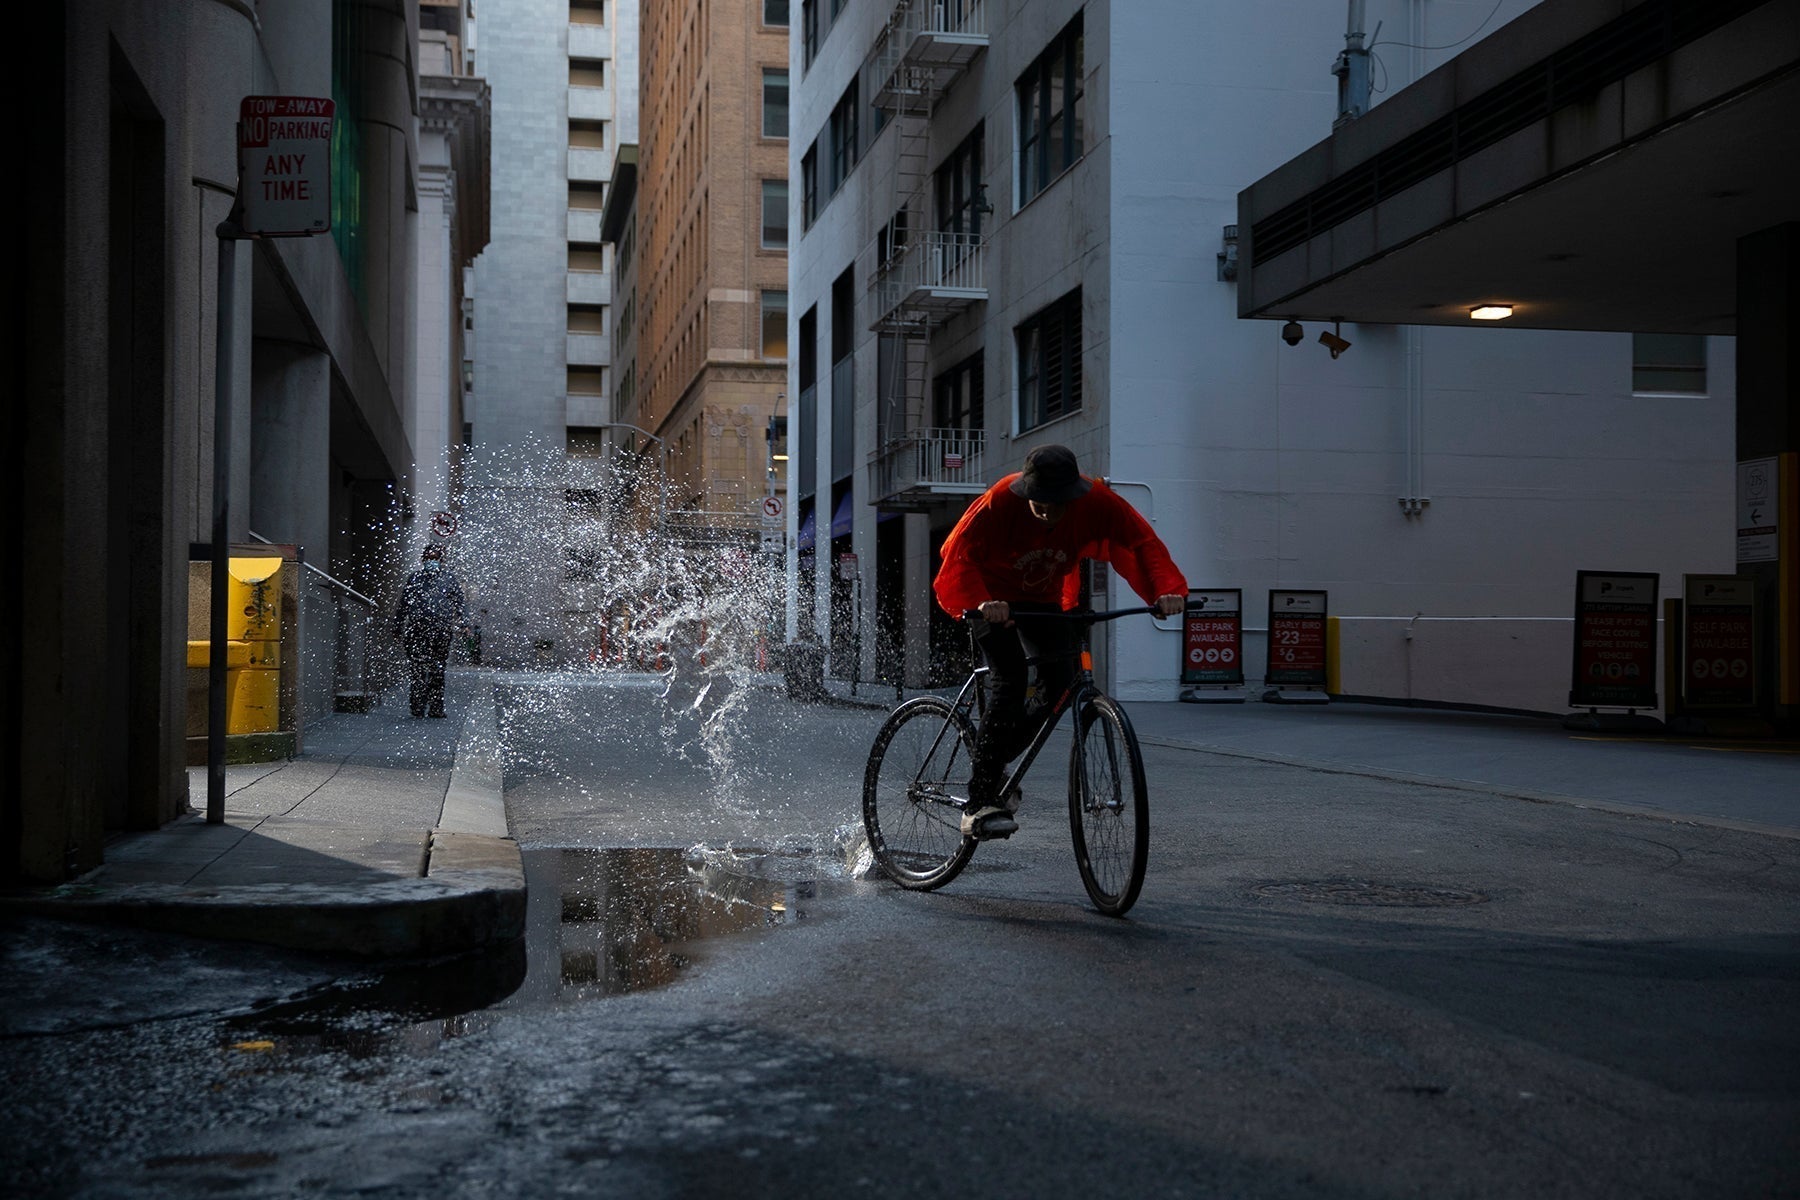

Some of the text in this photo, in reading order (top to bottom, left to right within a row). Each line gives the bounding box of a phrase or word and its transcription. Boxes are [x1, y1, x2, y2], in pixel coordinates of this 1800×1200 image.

[248, 99, 328, 114] TOW-AWAY
[242, 116, 330, 144] NO PARKING
[264, 154, 306, 176] ANY
[261, 180, 309, 201] TIME
[1190, 622, 1234, 631] SELF PARK
[1274, 621, 1300, 629] EARLY
[1692, 622, 1747, 633] SELF PARK
[1190, 634, 1235, 642] AVAILABLE
[1275, 630, 1300, 645] $23
[1691, 638, 1749, 649] AVAILABLE
[1279, 648, 1296, 662] $6
